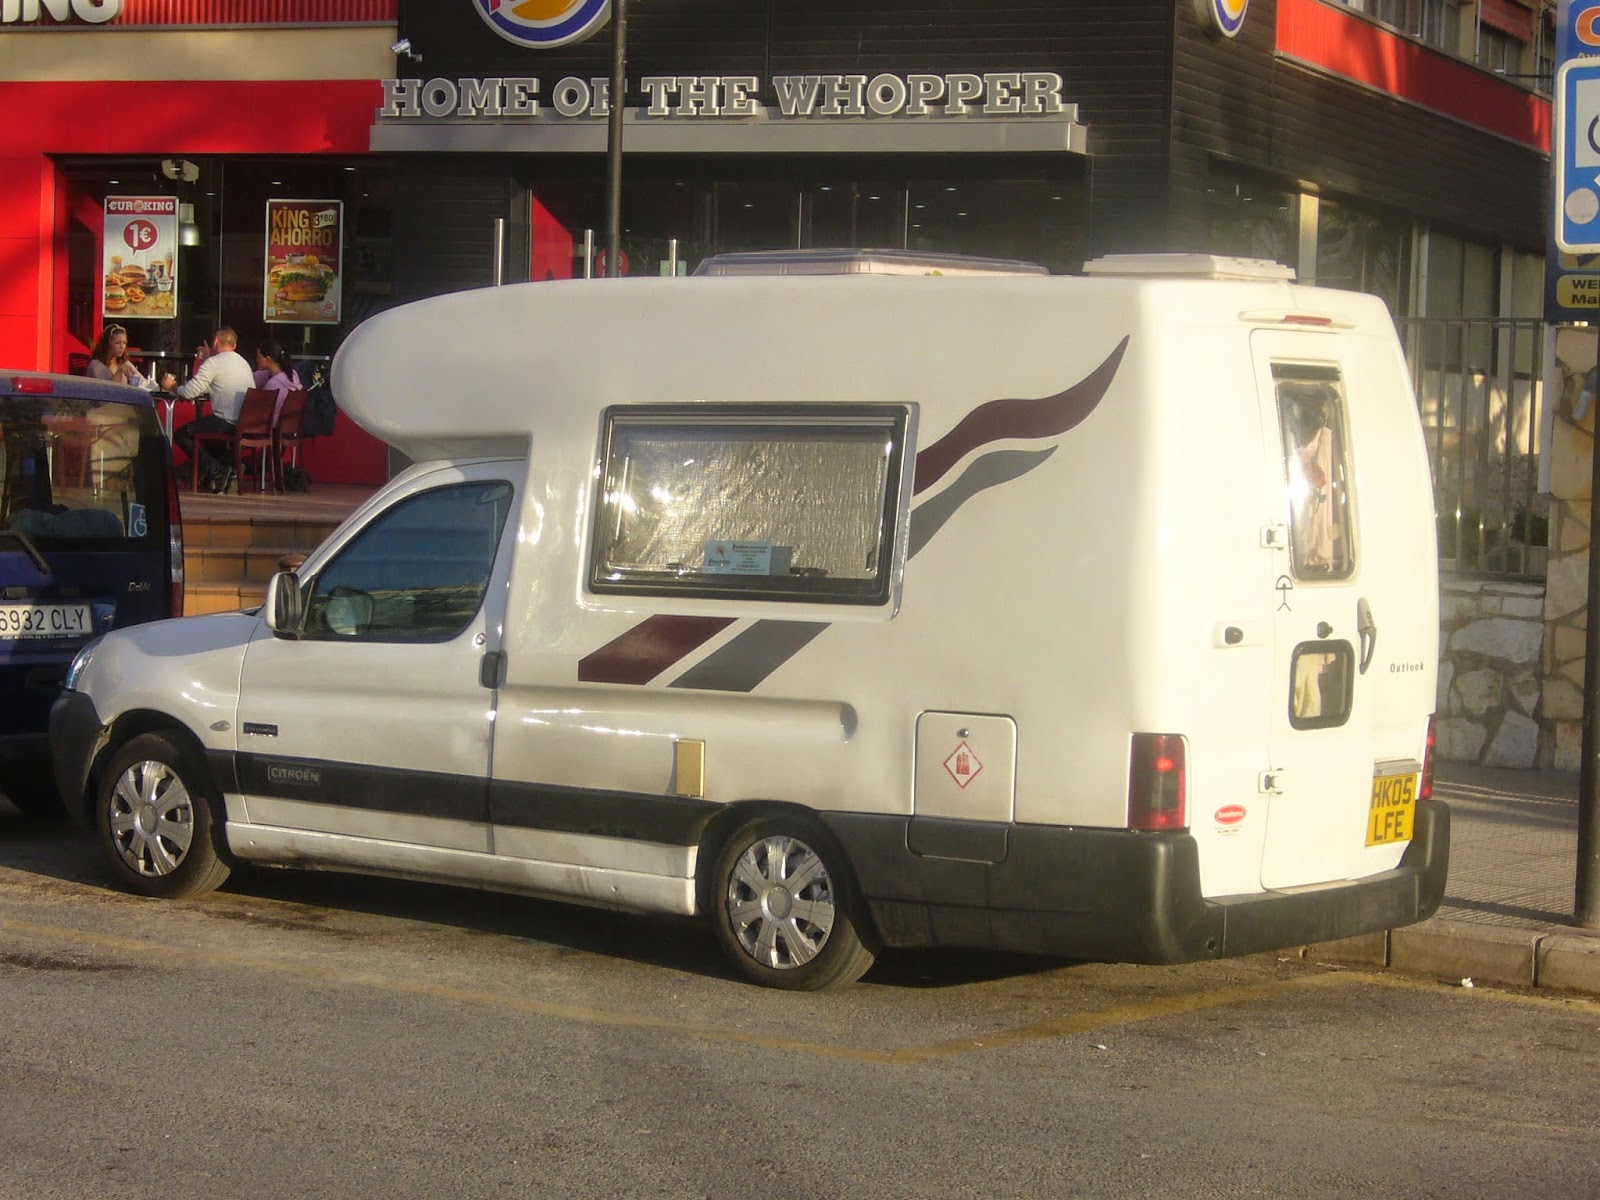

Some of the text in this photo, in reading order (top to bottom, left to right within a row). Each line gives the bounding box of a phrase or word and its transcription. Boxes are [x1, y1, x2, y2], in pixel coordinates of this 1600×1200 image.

[380, 78, 540, 117] HOME
[641, 76, 759, 116] THE
[772, 73, 1067, 116] WHOPPER
[271, 206, 310, 228] KING
[270, 227, 333, 246] AHORRO
[1390, 661, 1424, 673] Outlook
[1371, 776, 1413, 810] HK05
[1373, 810, 1405, 842] LFE
